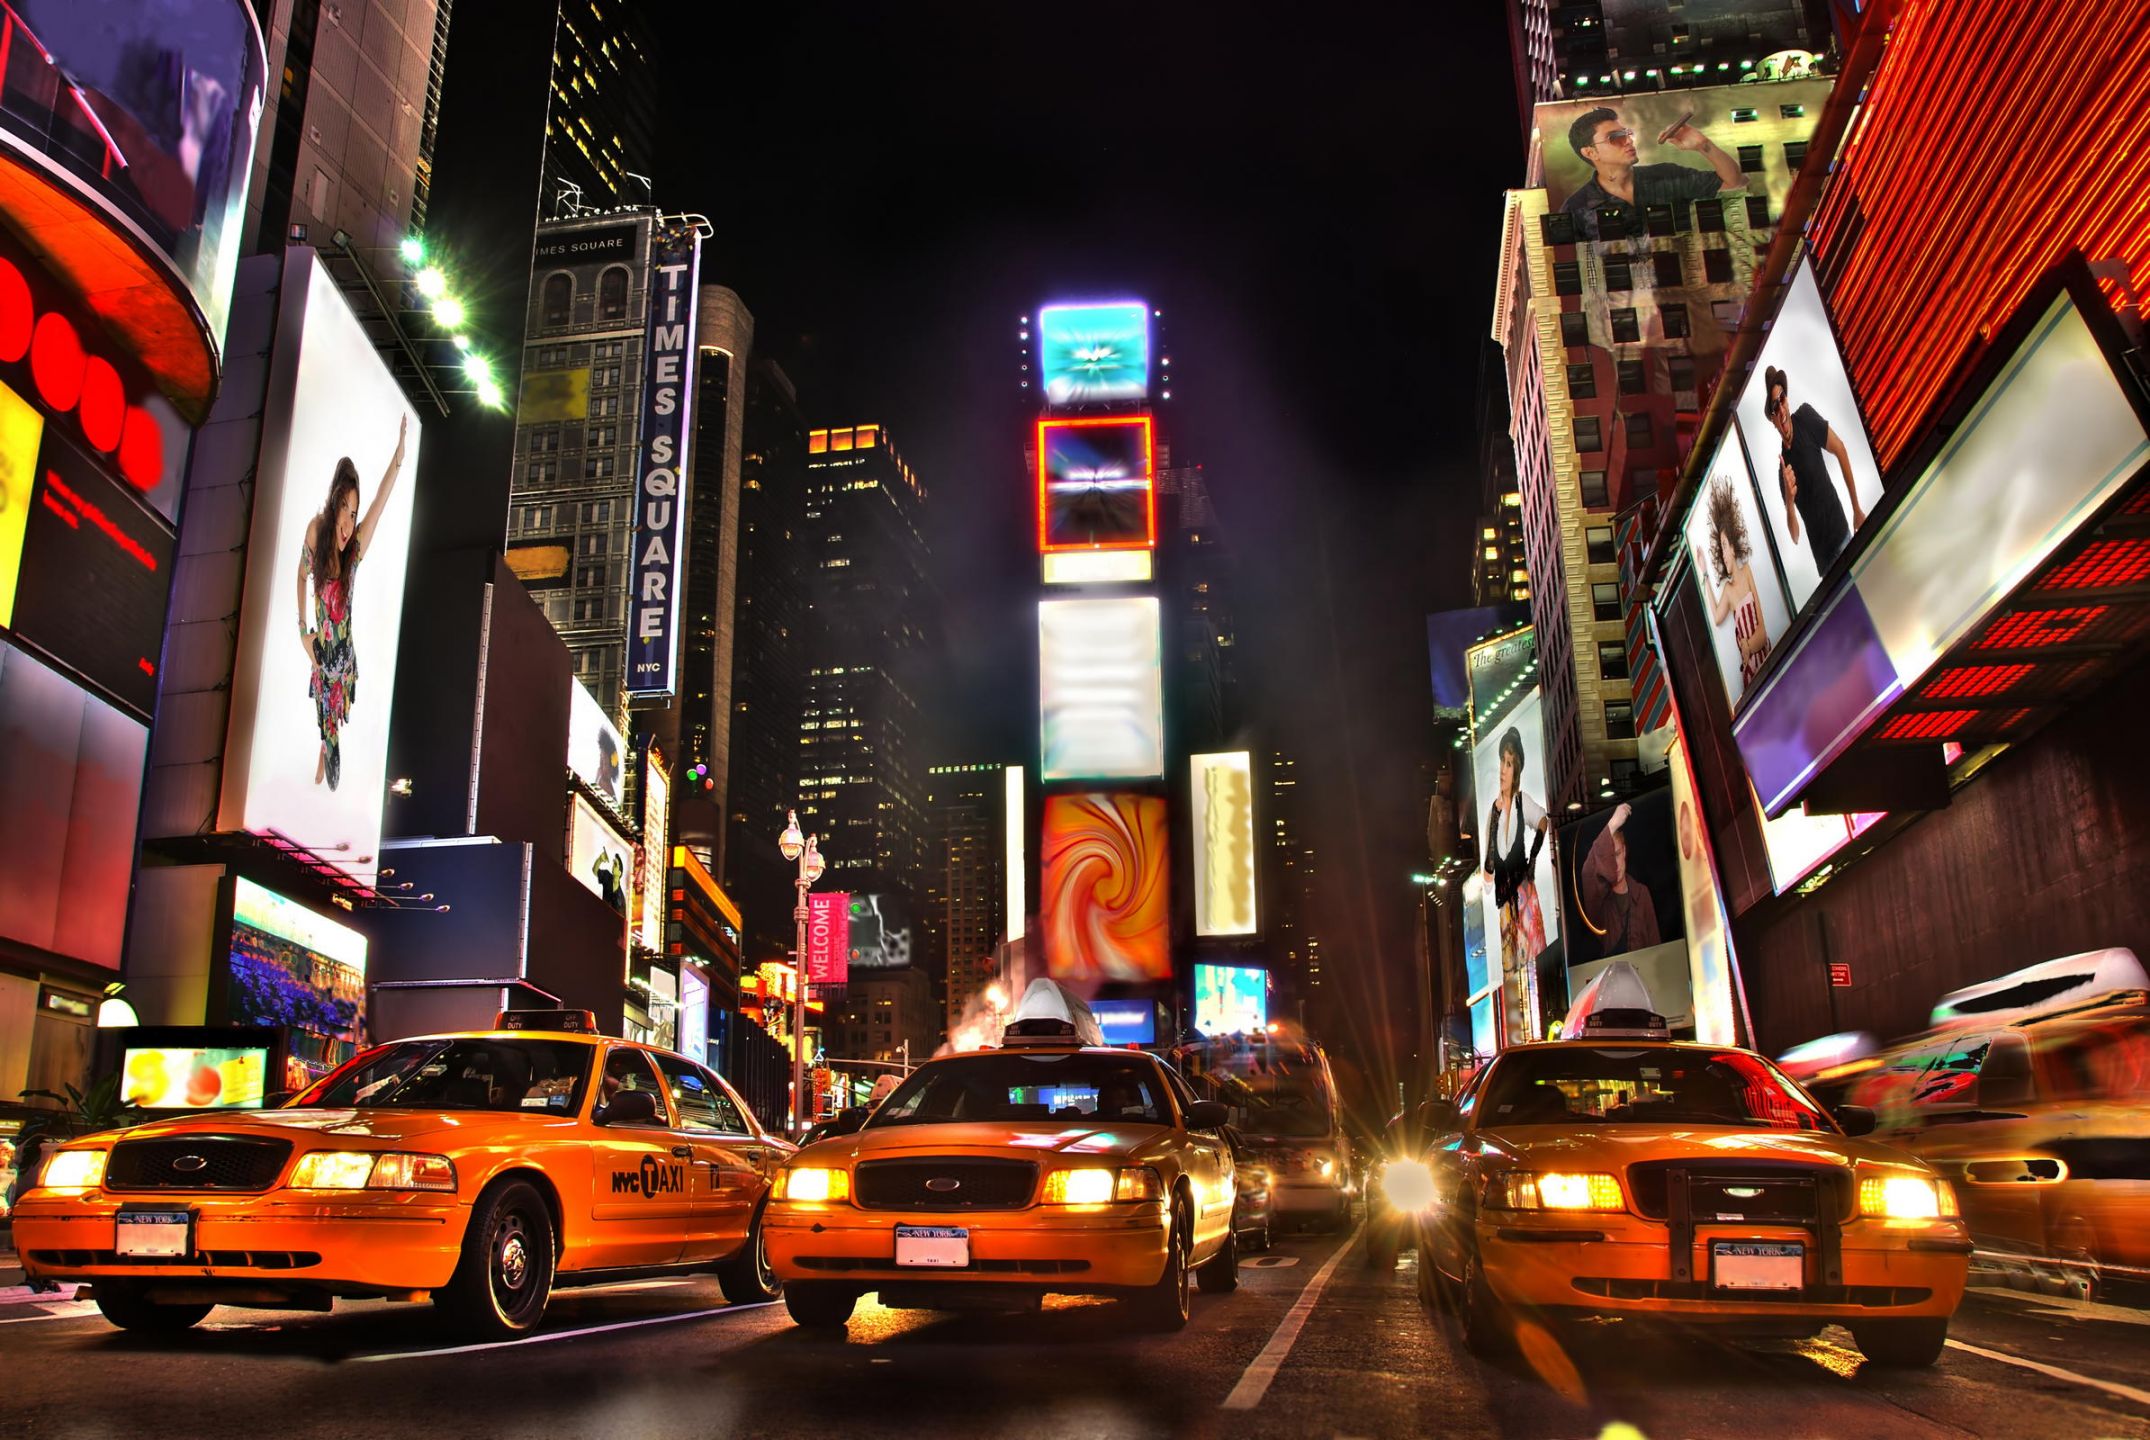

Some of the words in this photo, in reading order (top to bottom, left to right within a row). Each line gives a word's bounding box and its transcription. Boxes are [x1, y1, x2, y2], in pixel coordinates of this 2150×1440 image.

[535, 245, 566, 256] IMES
[571, 238, 624, 252] SQUARE
[655, 264, 688, 416] TIMES
[640, 435, 676, 638] SQUARE
[1474, 650, 1491, 668] The
[637, 662, 660, 673] NYC
[813, 899, 830, 980] WELCOME
[507, 1022, 522, 1030] DUTY
[563, 1021, 578, 1029] DUTY
[612, 1171, 640, 1193] NYC
[641, 1157, 684, 1196] TAXI
[135, 1215, 152, 1223] NEW
[153, 1215, 173, 1224] YORK
[914, 1230, 930, 1238] NEW
[932, 1230, 952, 1238] YORK
[1735, 1247, 1755, 1255] NEW
[1757, 1247, 1781, 1256] YORK
